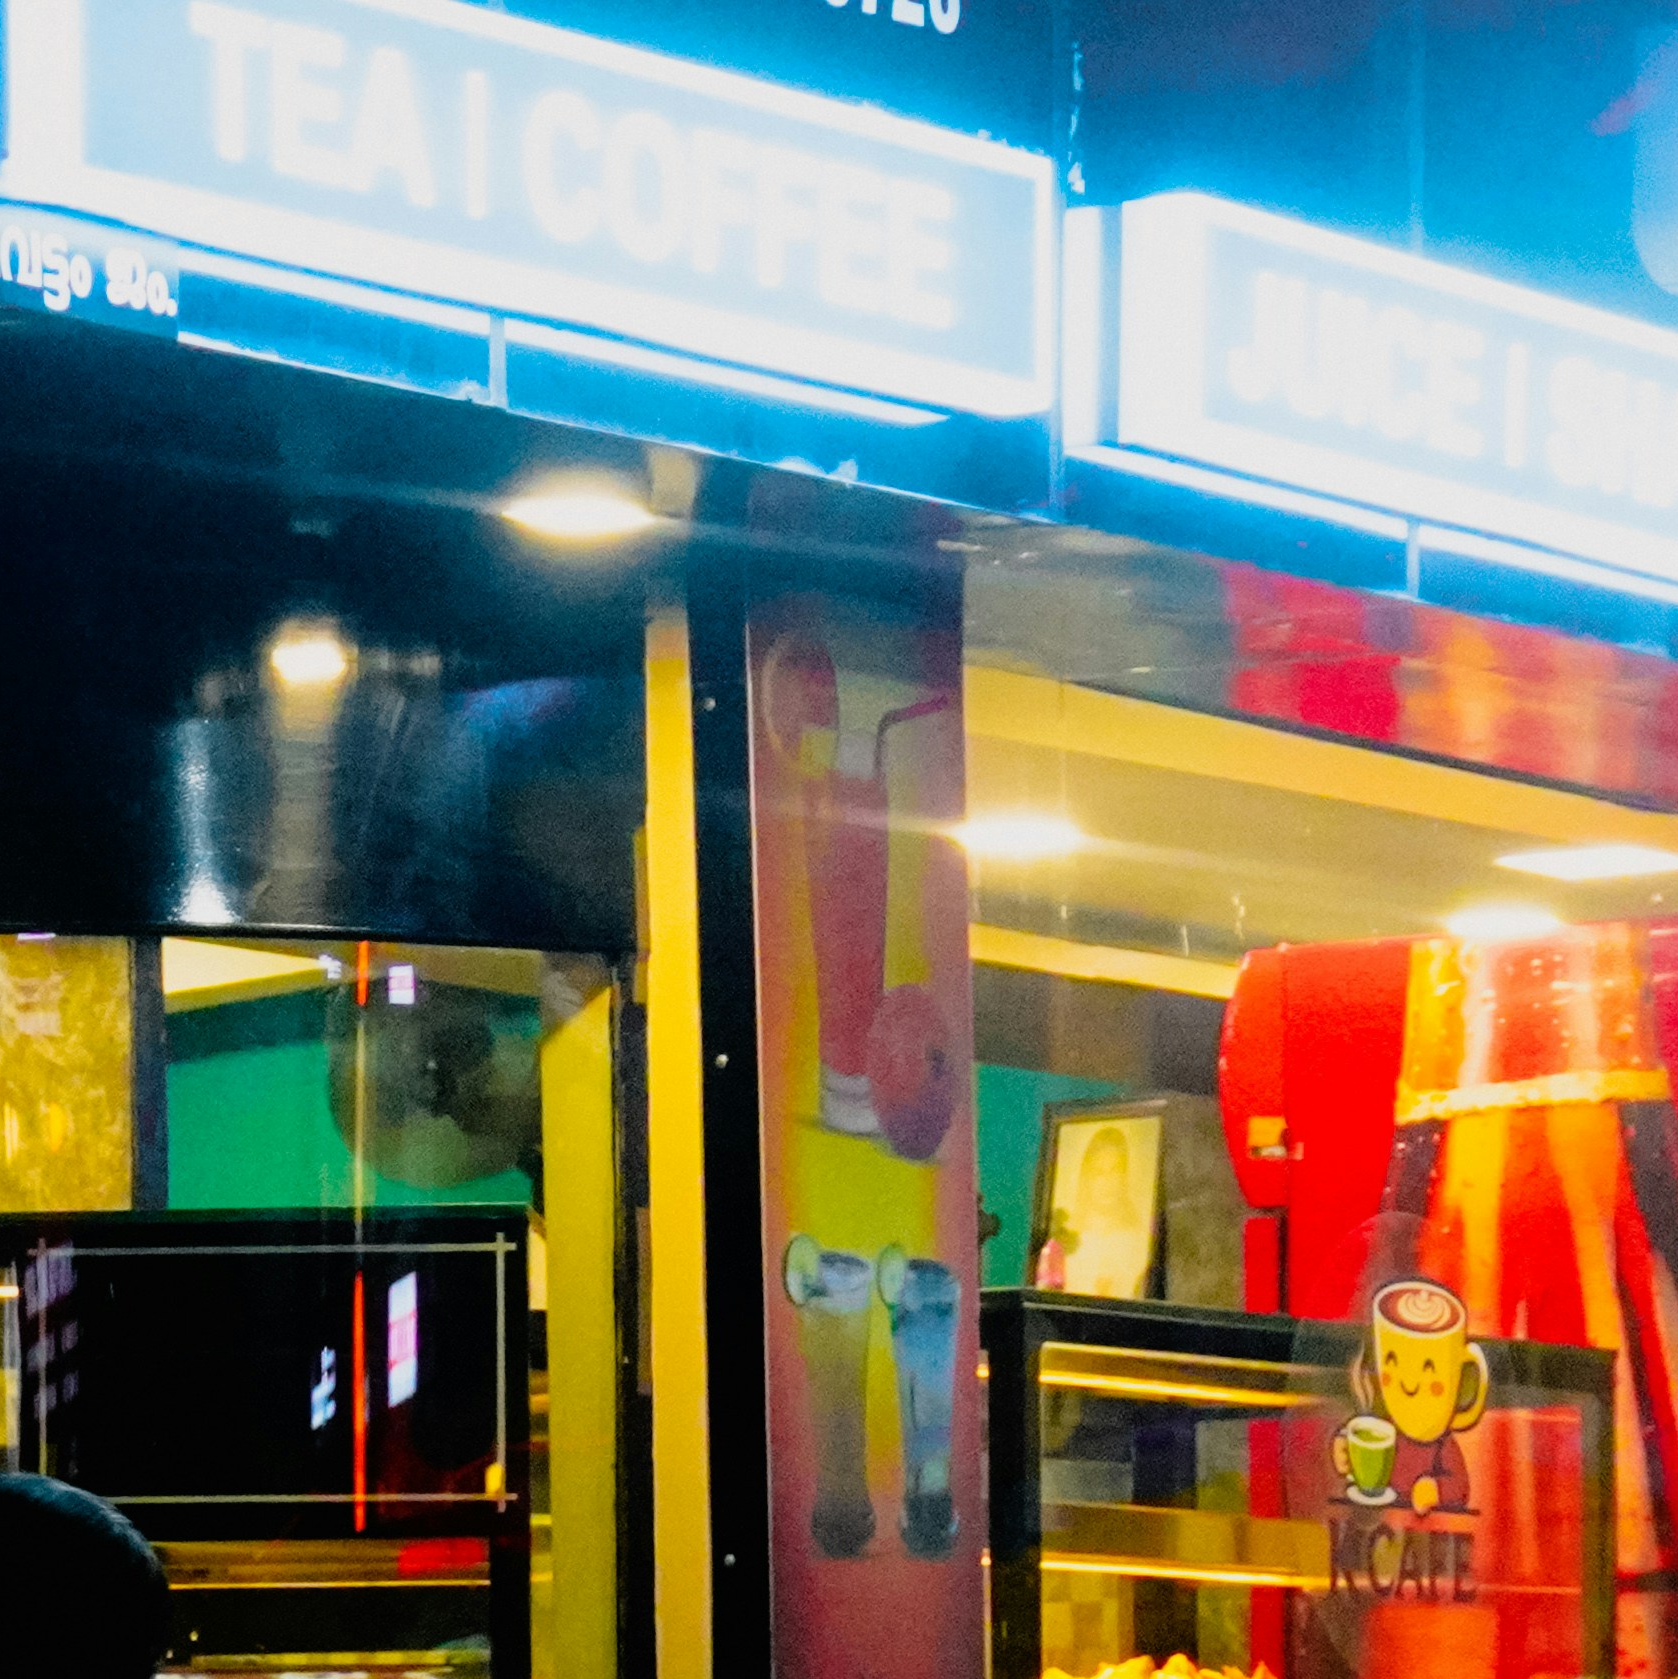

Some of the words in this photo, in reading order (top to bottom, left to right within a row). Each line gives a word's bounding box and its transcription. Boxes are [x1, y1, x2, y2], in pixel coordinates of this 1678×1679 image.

[187, 0, 435, 209] TEA
[522, 88, 956, 331] COFFEE
[1227, 269, 1484, 459] JUICE
